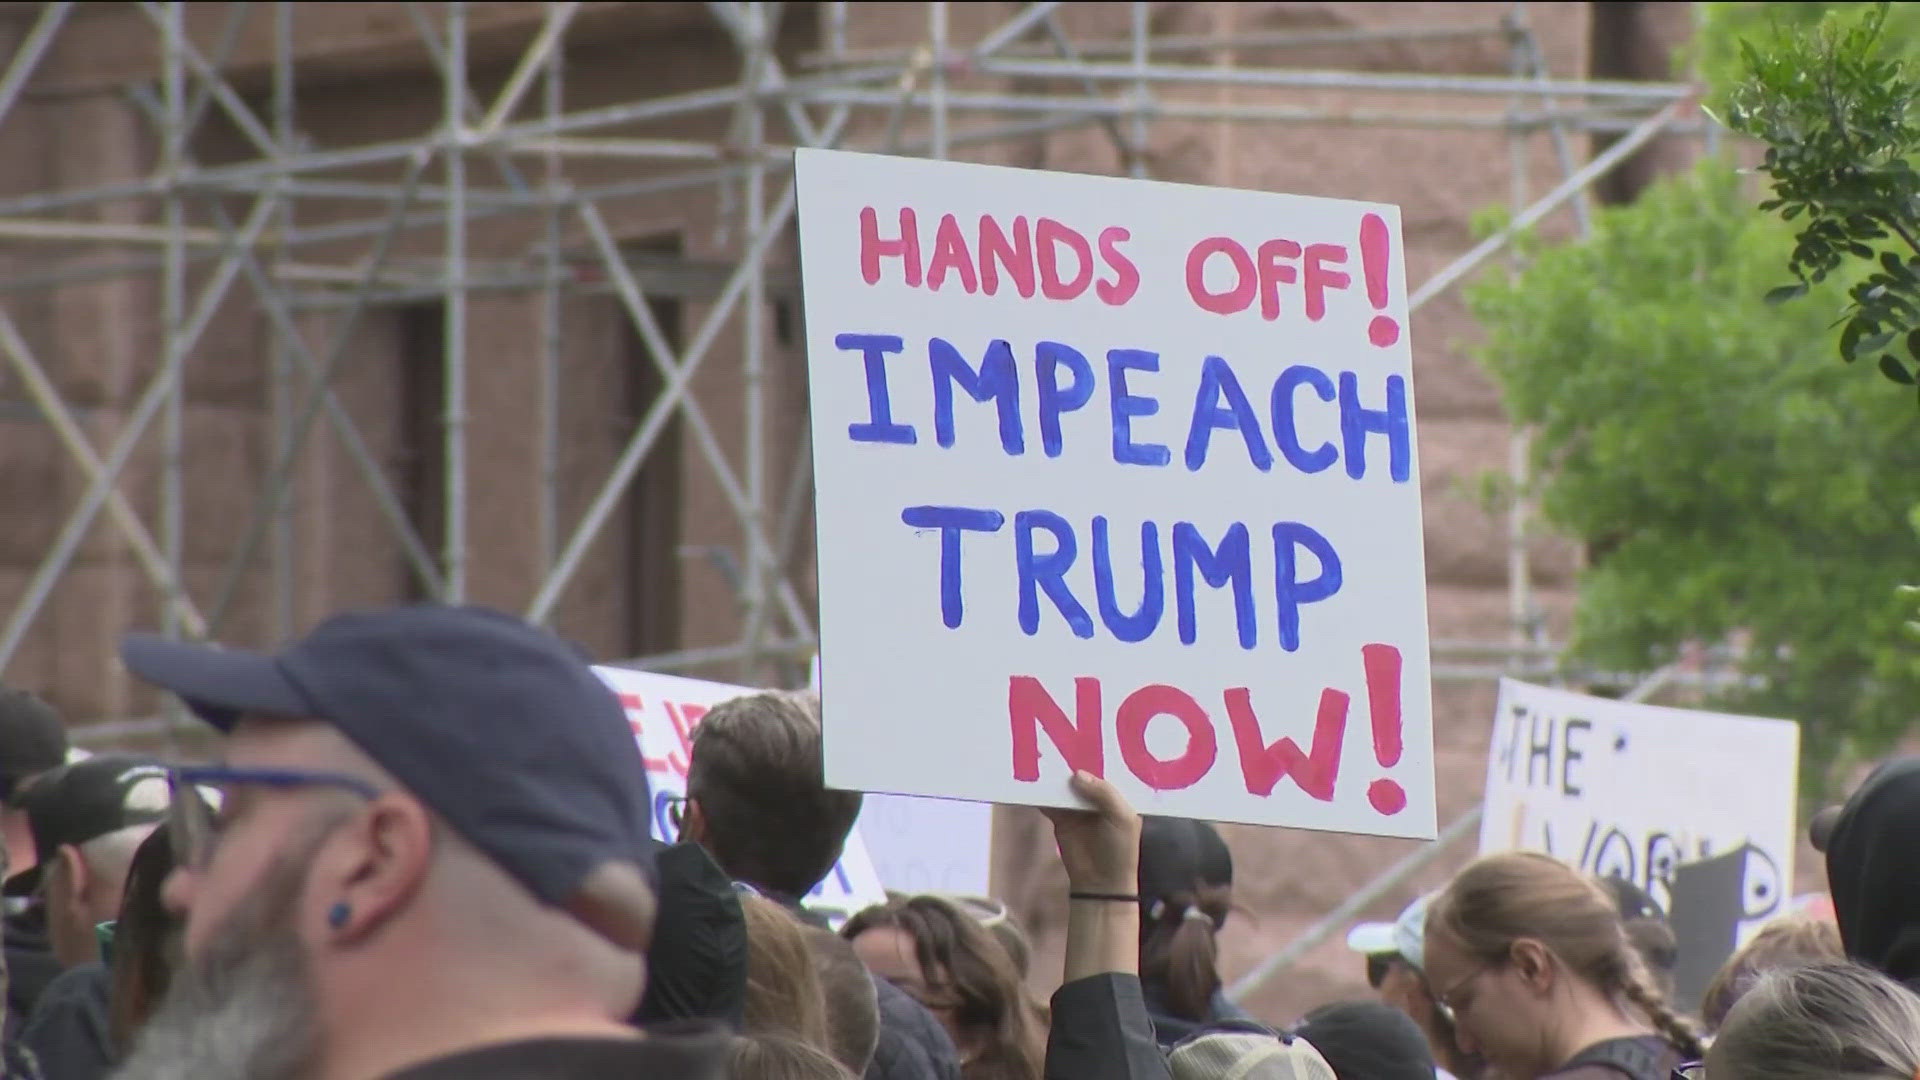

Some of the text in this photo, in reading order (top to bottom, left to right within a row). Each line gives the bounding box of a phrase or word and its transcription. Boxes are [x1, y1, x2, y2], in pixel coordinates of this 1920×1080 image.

[860, 207, 1400, 347] HANDS OFF!
[835, 333, 1410, 483] IMPEACH
[901, 505, 1343, 652] TRUMP
[1009, 643, 1407, 815] NOW!
[1510, 705, 1592, 796] THE
